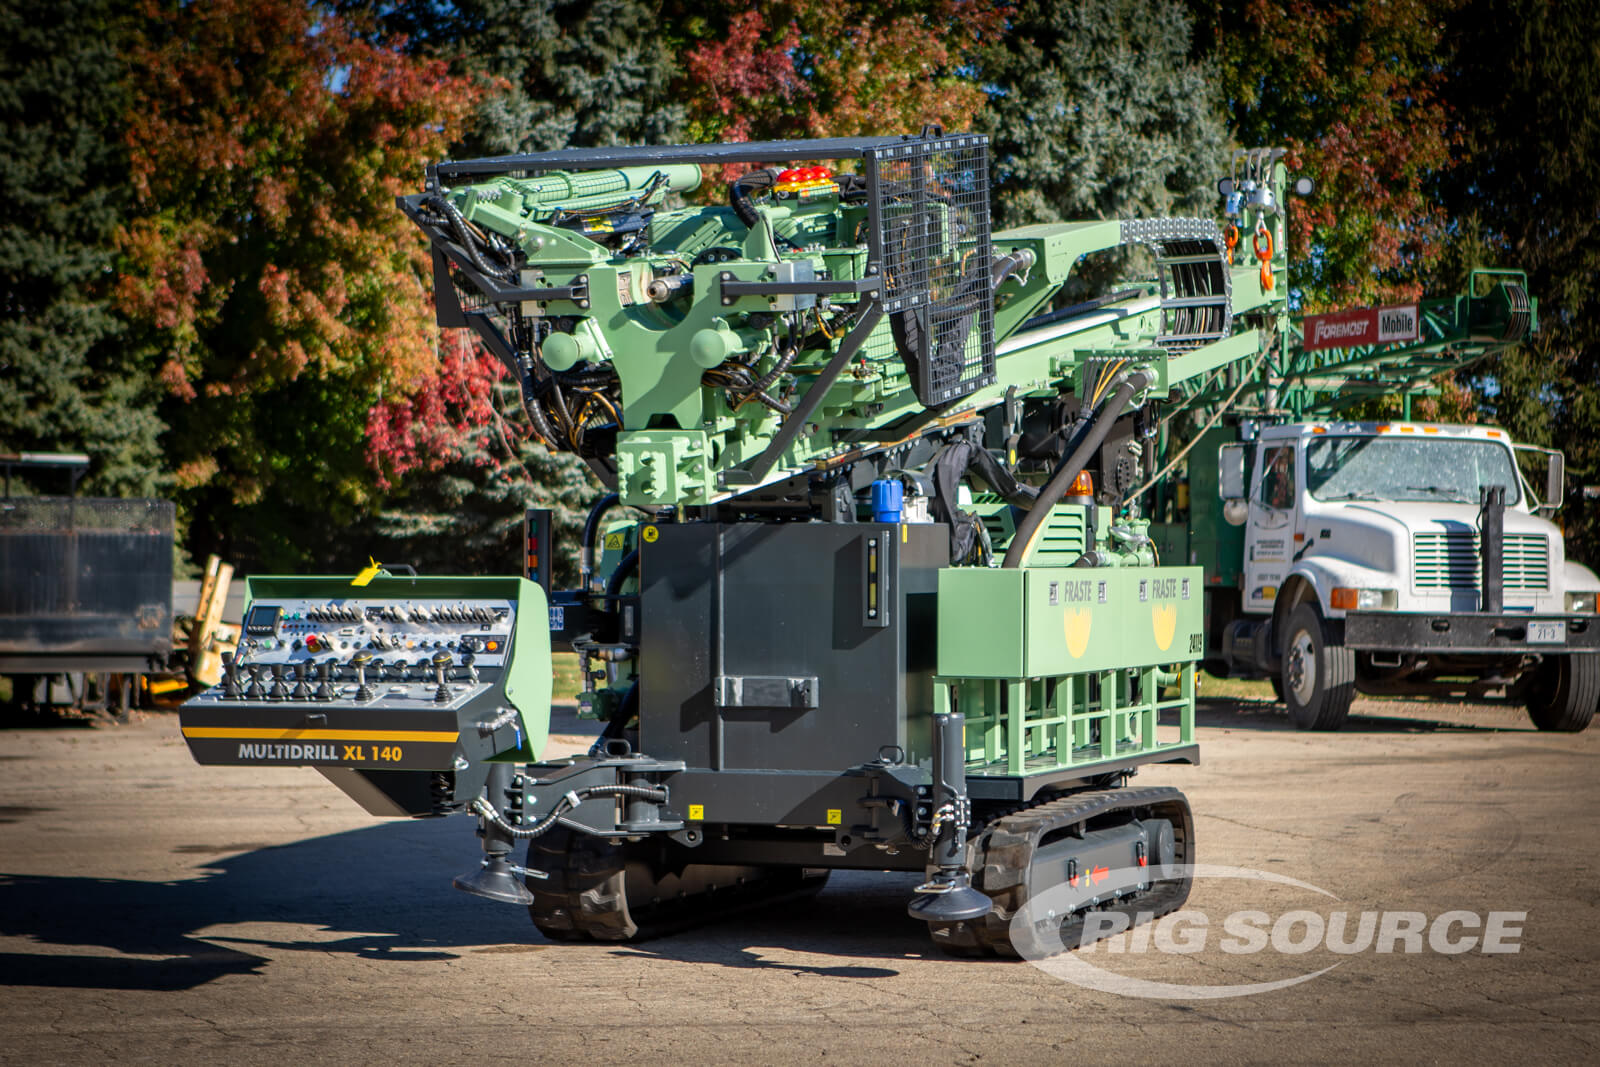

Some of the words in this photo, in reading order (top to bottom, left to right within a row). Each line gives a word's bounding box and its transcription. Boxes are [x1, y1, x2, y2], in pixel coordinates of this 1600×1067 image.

[1314, 319, 1370, 344] FOREMOST
[1382, 312, 1413, 334] Mobile
[1064, 580, 1092, 602] FRASTE
[1152, 578, 1177, 599] FRASTE
[238, 743, 339, 760] MULTIDRILL
[343, 745, 366, 761] XL
[372, 745, 403, 762] 140
